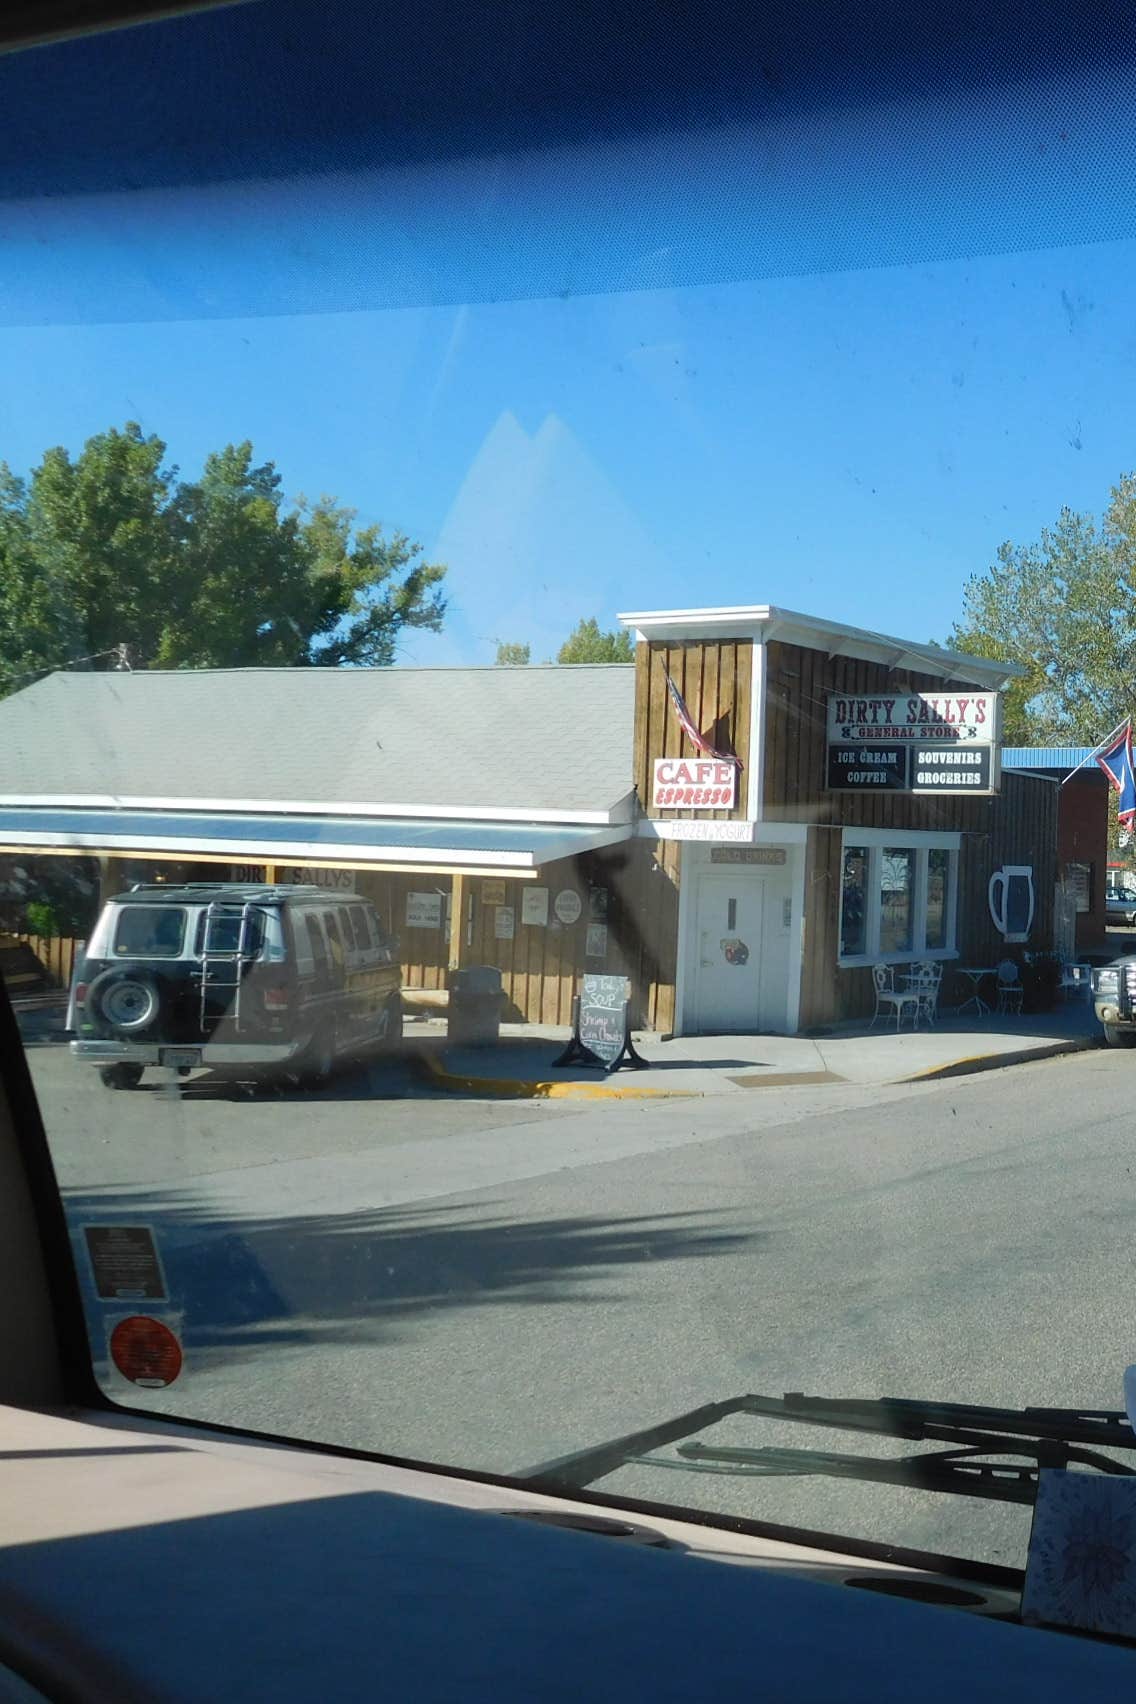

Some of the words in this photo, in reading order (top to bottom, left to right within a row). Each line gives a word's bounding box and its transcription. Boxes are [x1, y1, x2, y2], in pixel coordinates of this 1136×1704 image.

[835, 699, 896, 724] DIRTY
[906, 699, 987, 724] SALLY'S
[858, 727, 915, 738] GENERAL
[920, 727, 961, 738] STORE
[838, 752, 855, 764] ICE
[859, 752, 897, 764] CREAM
[918, 751, 982, 765] SOUVENIRS
[656, 762, 732, 785] CAFE
[847, 771, 887, 784] COFFEE
[917, 771, 981, 785] GROCERIES
[655, 787, 732, 805] ESPRESSO
